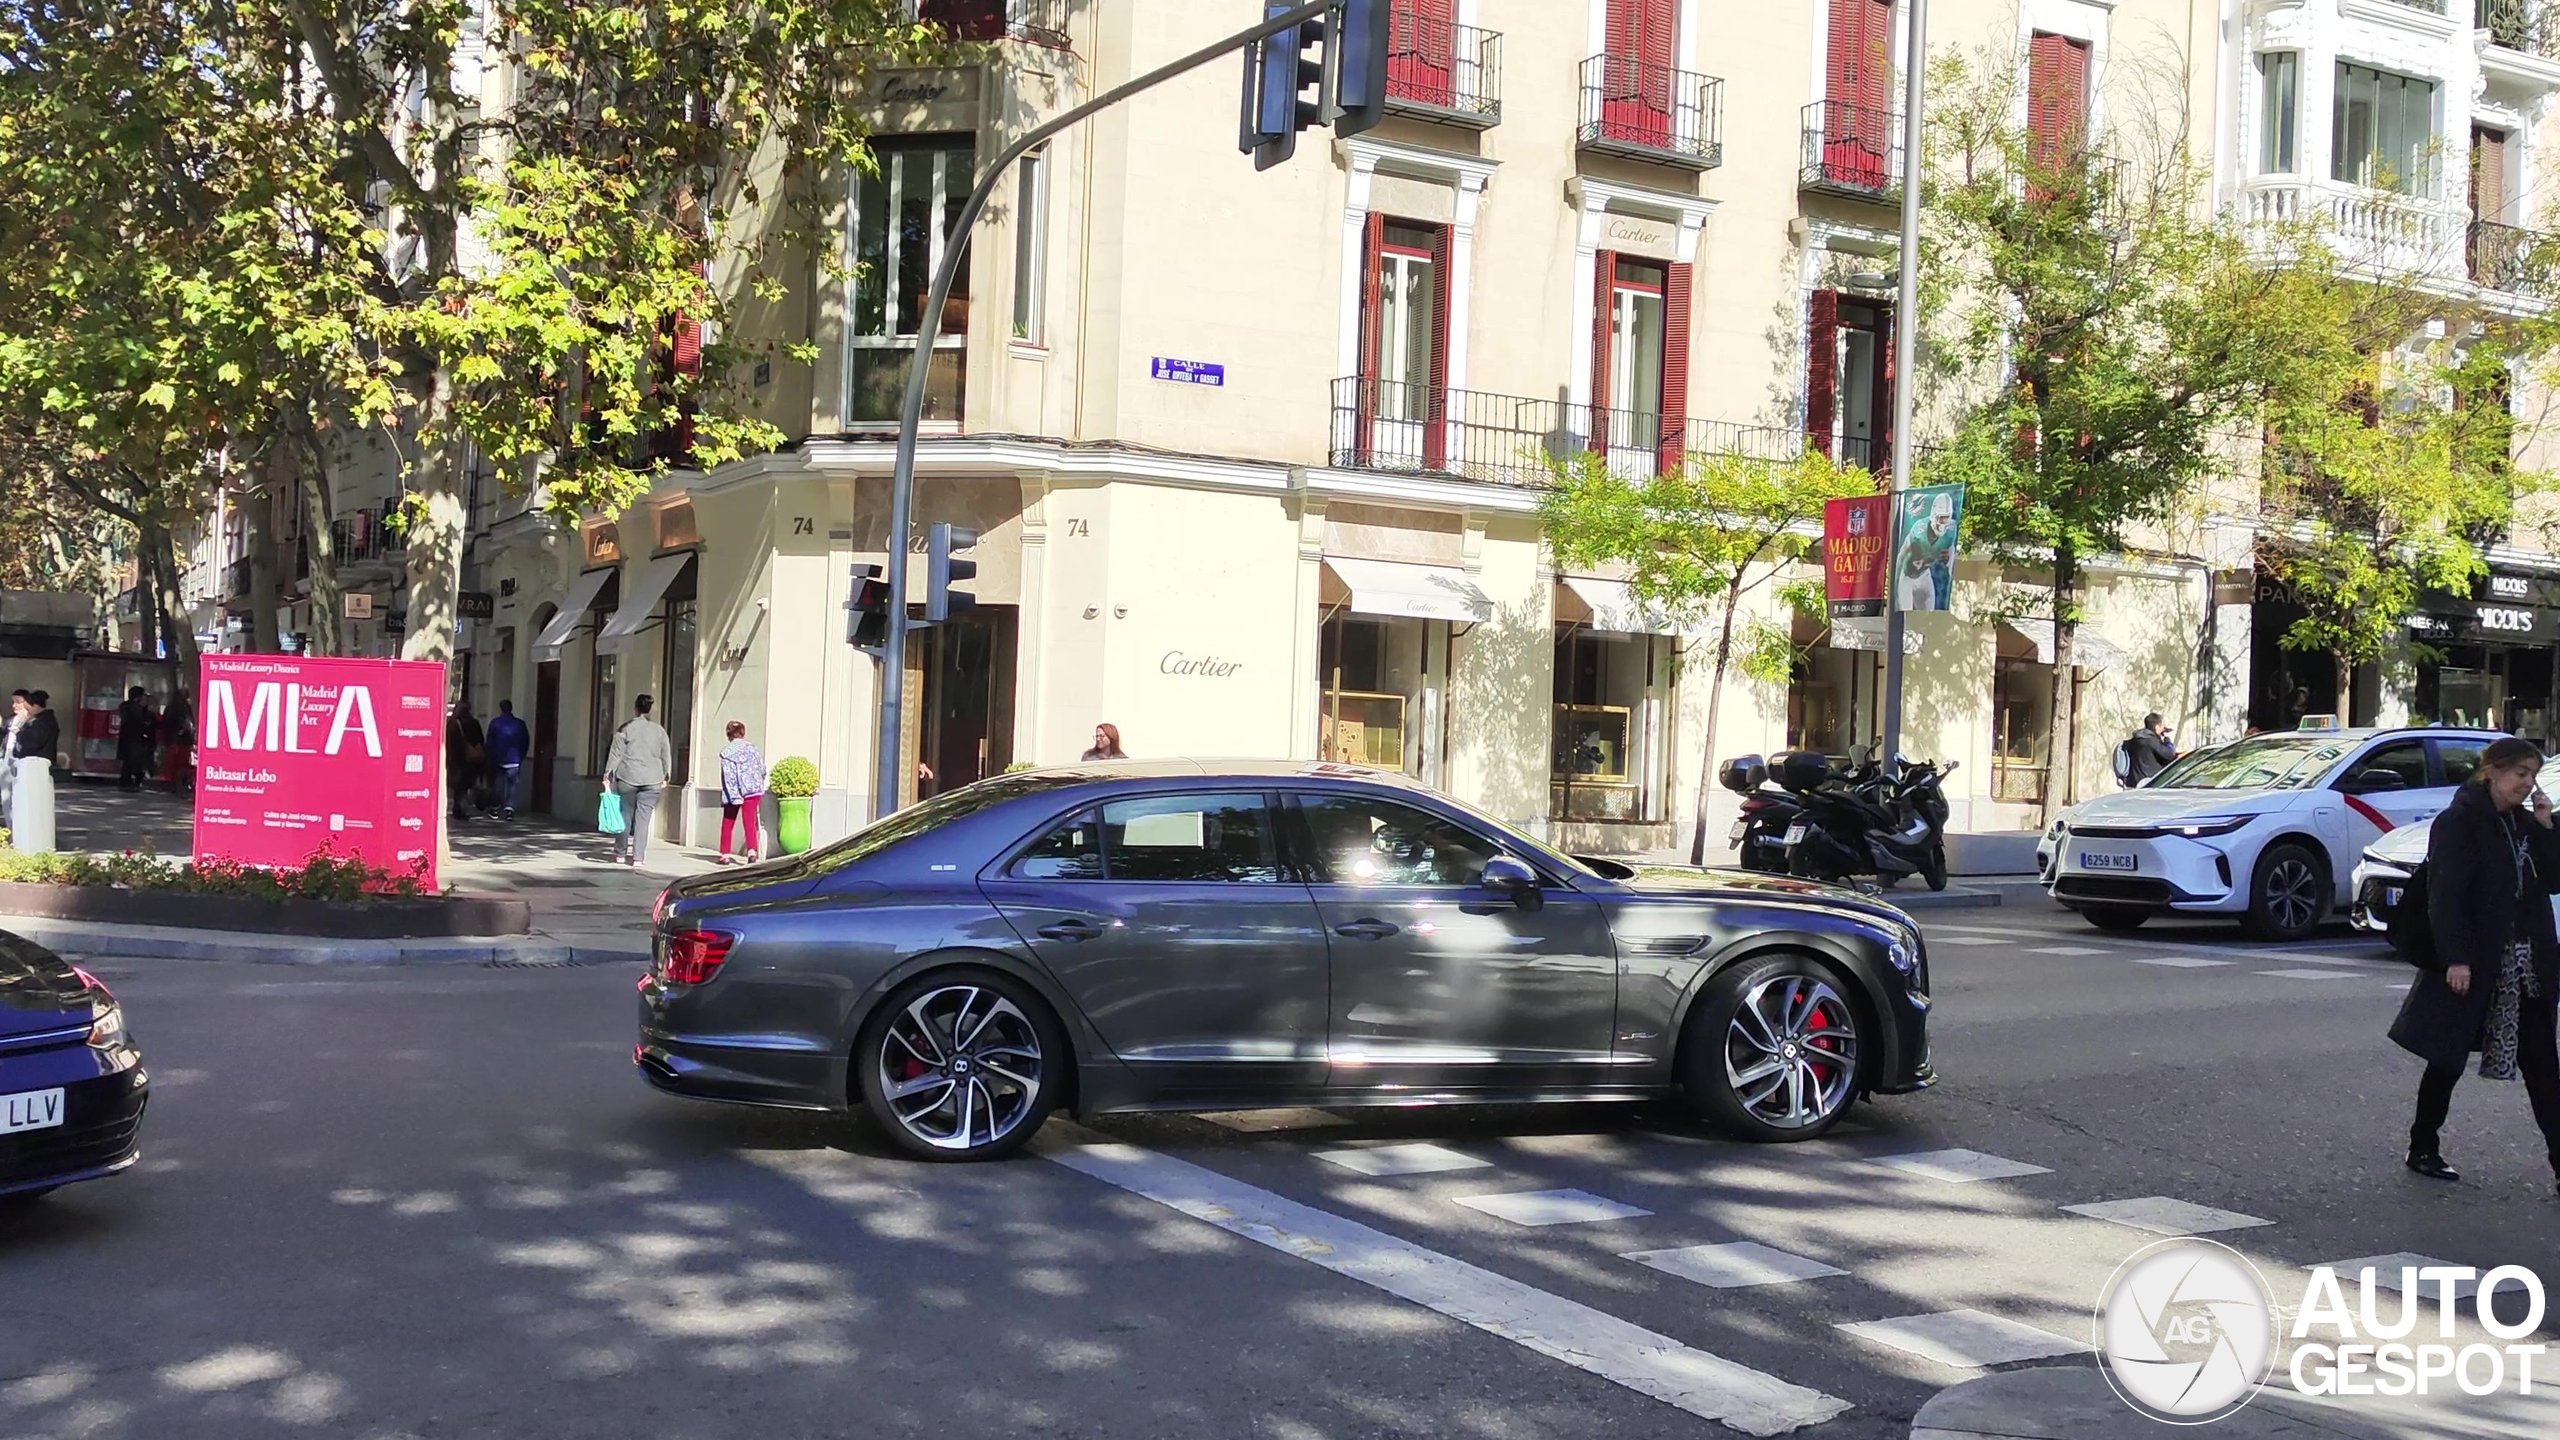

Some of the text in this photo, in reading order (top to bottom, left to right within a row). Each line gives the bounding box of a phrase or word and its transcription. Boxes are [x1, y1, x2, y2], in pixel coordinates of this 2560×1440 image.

[881, 76, 948, 102] Cartier
[1608, 219, 1660, 244] Cartier
[1173, 360, 1206, 370] CALLE
[1156, 369, 1220, 385] JOSÉ ORTEGA Y GASSET
[793, 517, 814, 535] 74
[1068, 518, 1089, 537] 74
[1850, 520, 1864, 532] NFL
[1828, 536, 1882, 555] MADRID
[1833, 555, 1874, 573] GAME
[2492, 577, 2528, 593] NICOLS
[1406, 599, 1438, 613] Cartier
[1840, 604, 1866, 612] MADRID
[209, 661, 300, 675] by Madrid Luxury District
[1160, 650, 1242, 677] Cartier
[300, 685, 338, 699] Madrid
[300, 700, 335, 716] Luxury
[300, 713, 318, 725] Art
[205, 766, 277, 783] Baltasar Lobo
[2087, 854, 2132, 867] 6259 NCB
[10, 1094, 57, 1127] LLV
